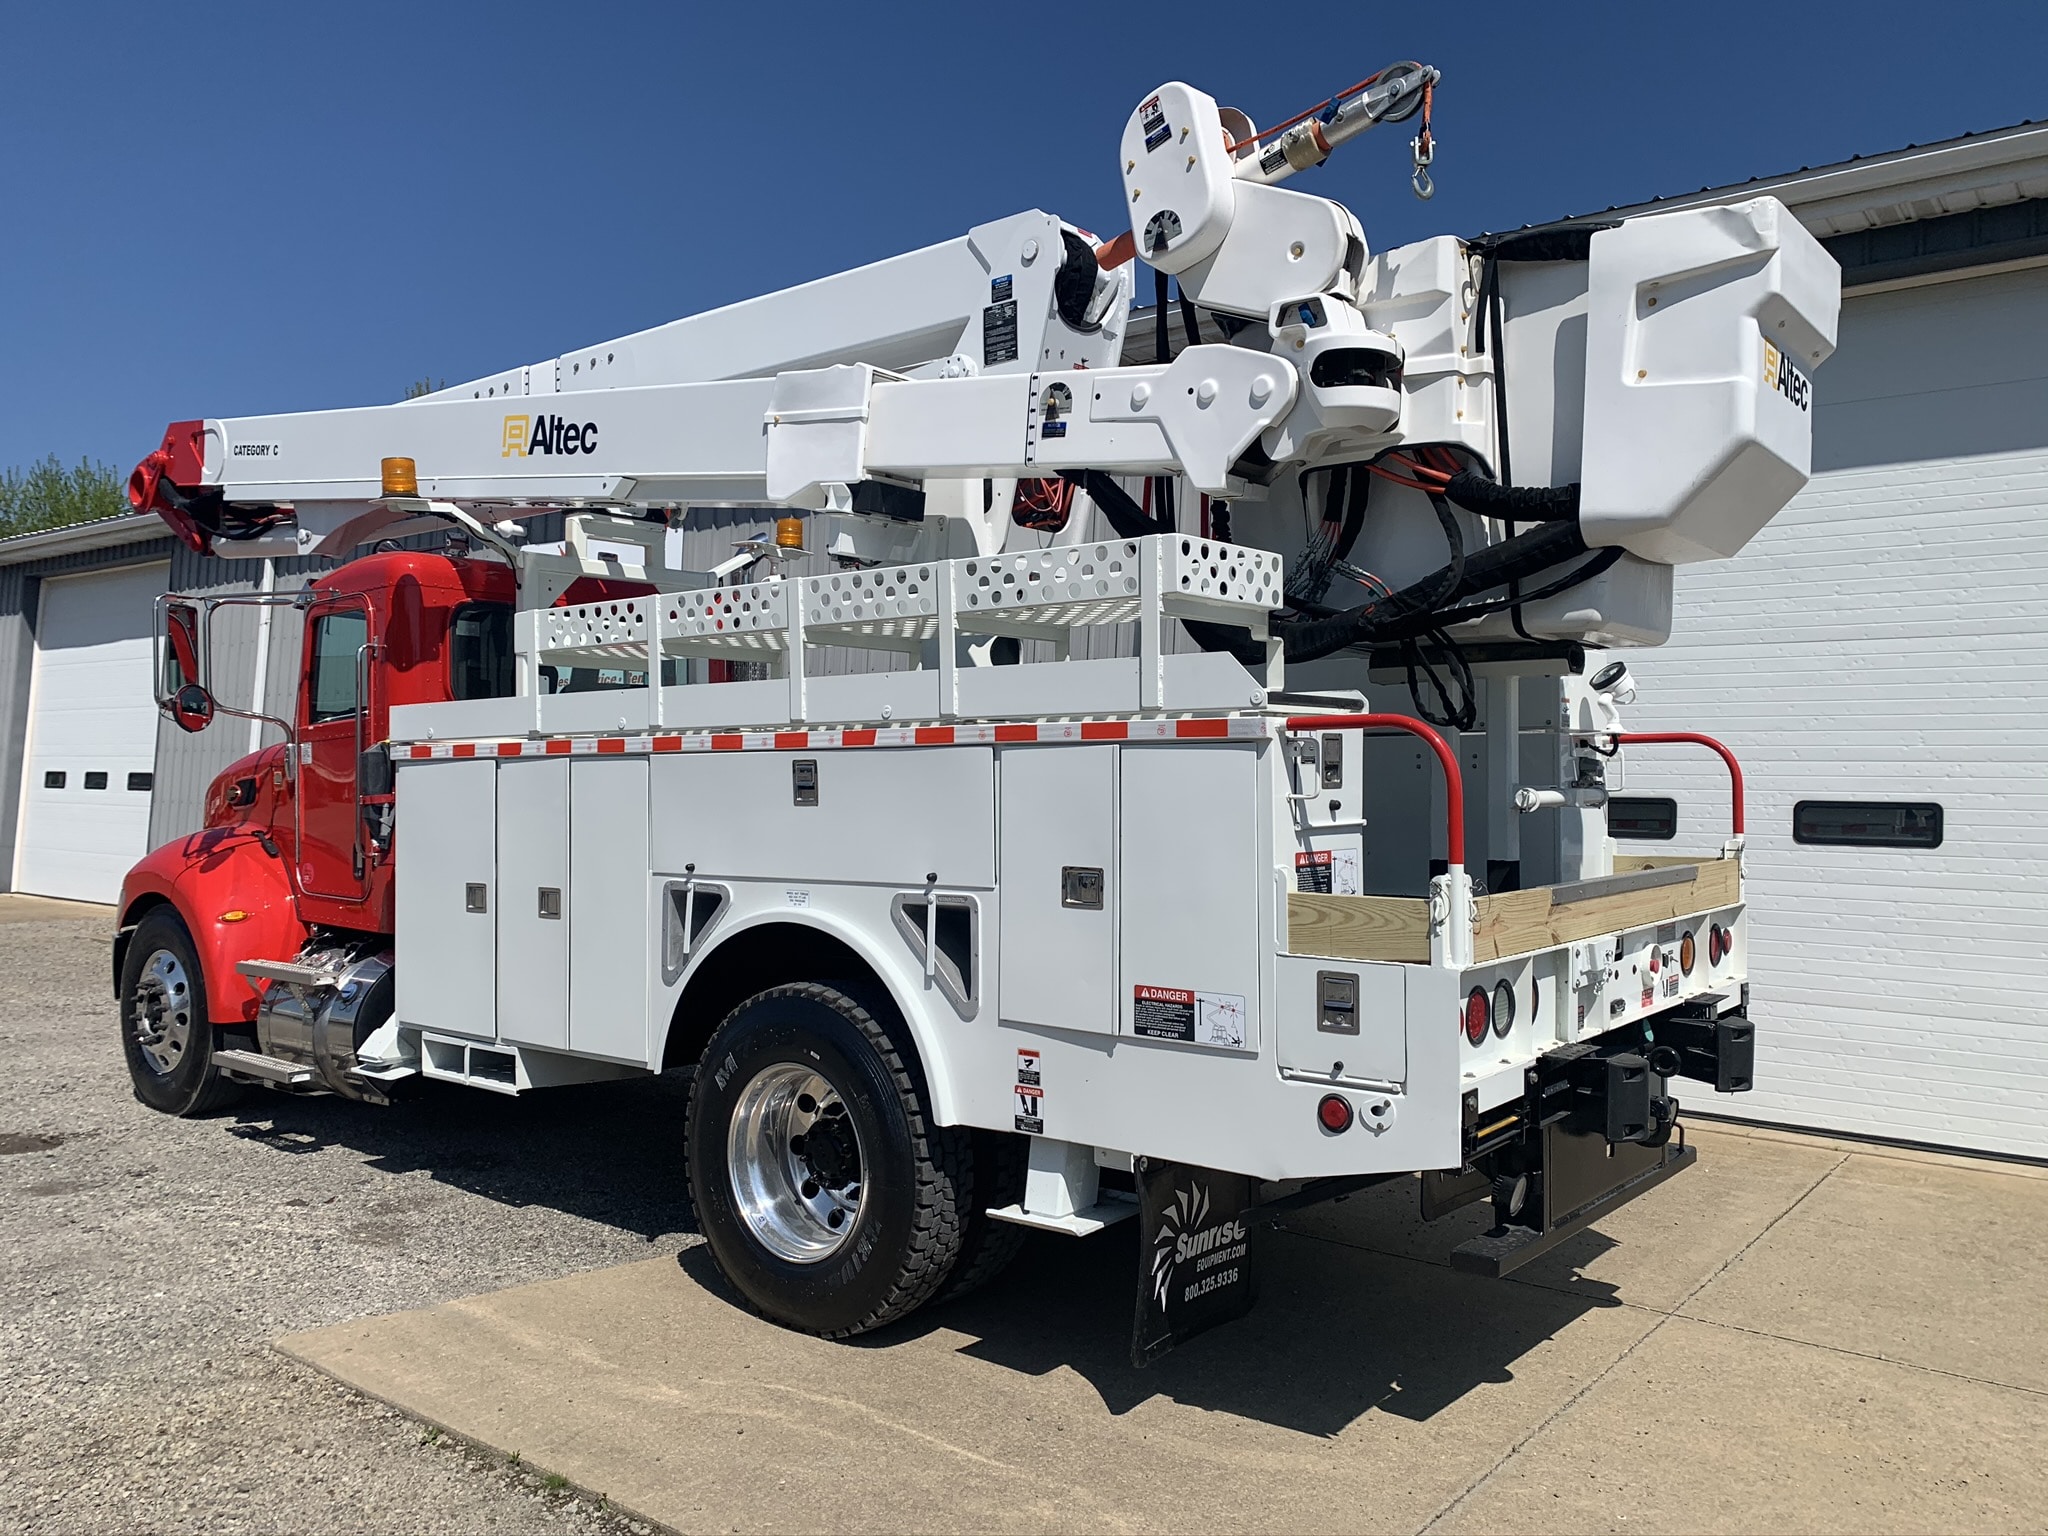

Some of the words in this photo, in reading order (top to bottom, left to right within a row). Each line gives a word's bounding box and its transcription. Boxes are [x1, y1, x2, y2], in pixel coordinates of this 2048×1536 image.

[1777, 351, 1808, 411] Altec
[528, 414, 598, 455] Altec
[234, 445, 270, 456] CATEGORY
[273, 445, 279, 456] C
[1150, 989, 1188, 1002] DANGER
[1161, 1031, 1179, 1039] CLEAR
[1022, 1088, 1041, 1096] DANGER
[1196, 1243, 1246, 1273] EQUIPMENT.COM
[1184, 1267, 1239, 1302] 800.325.9336
